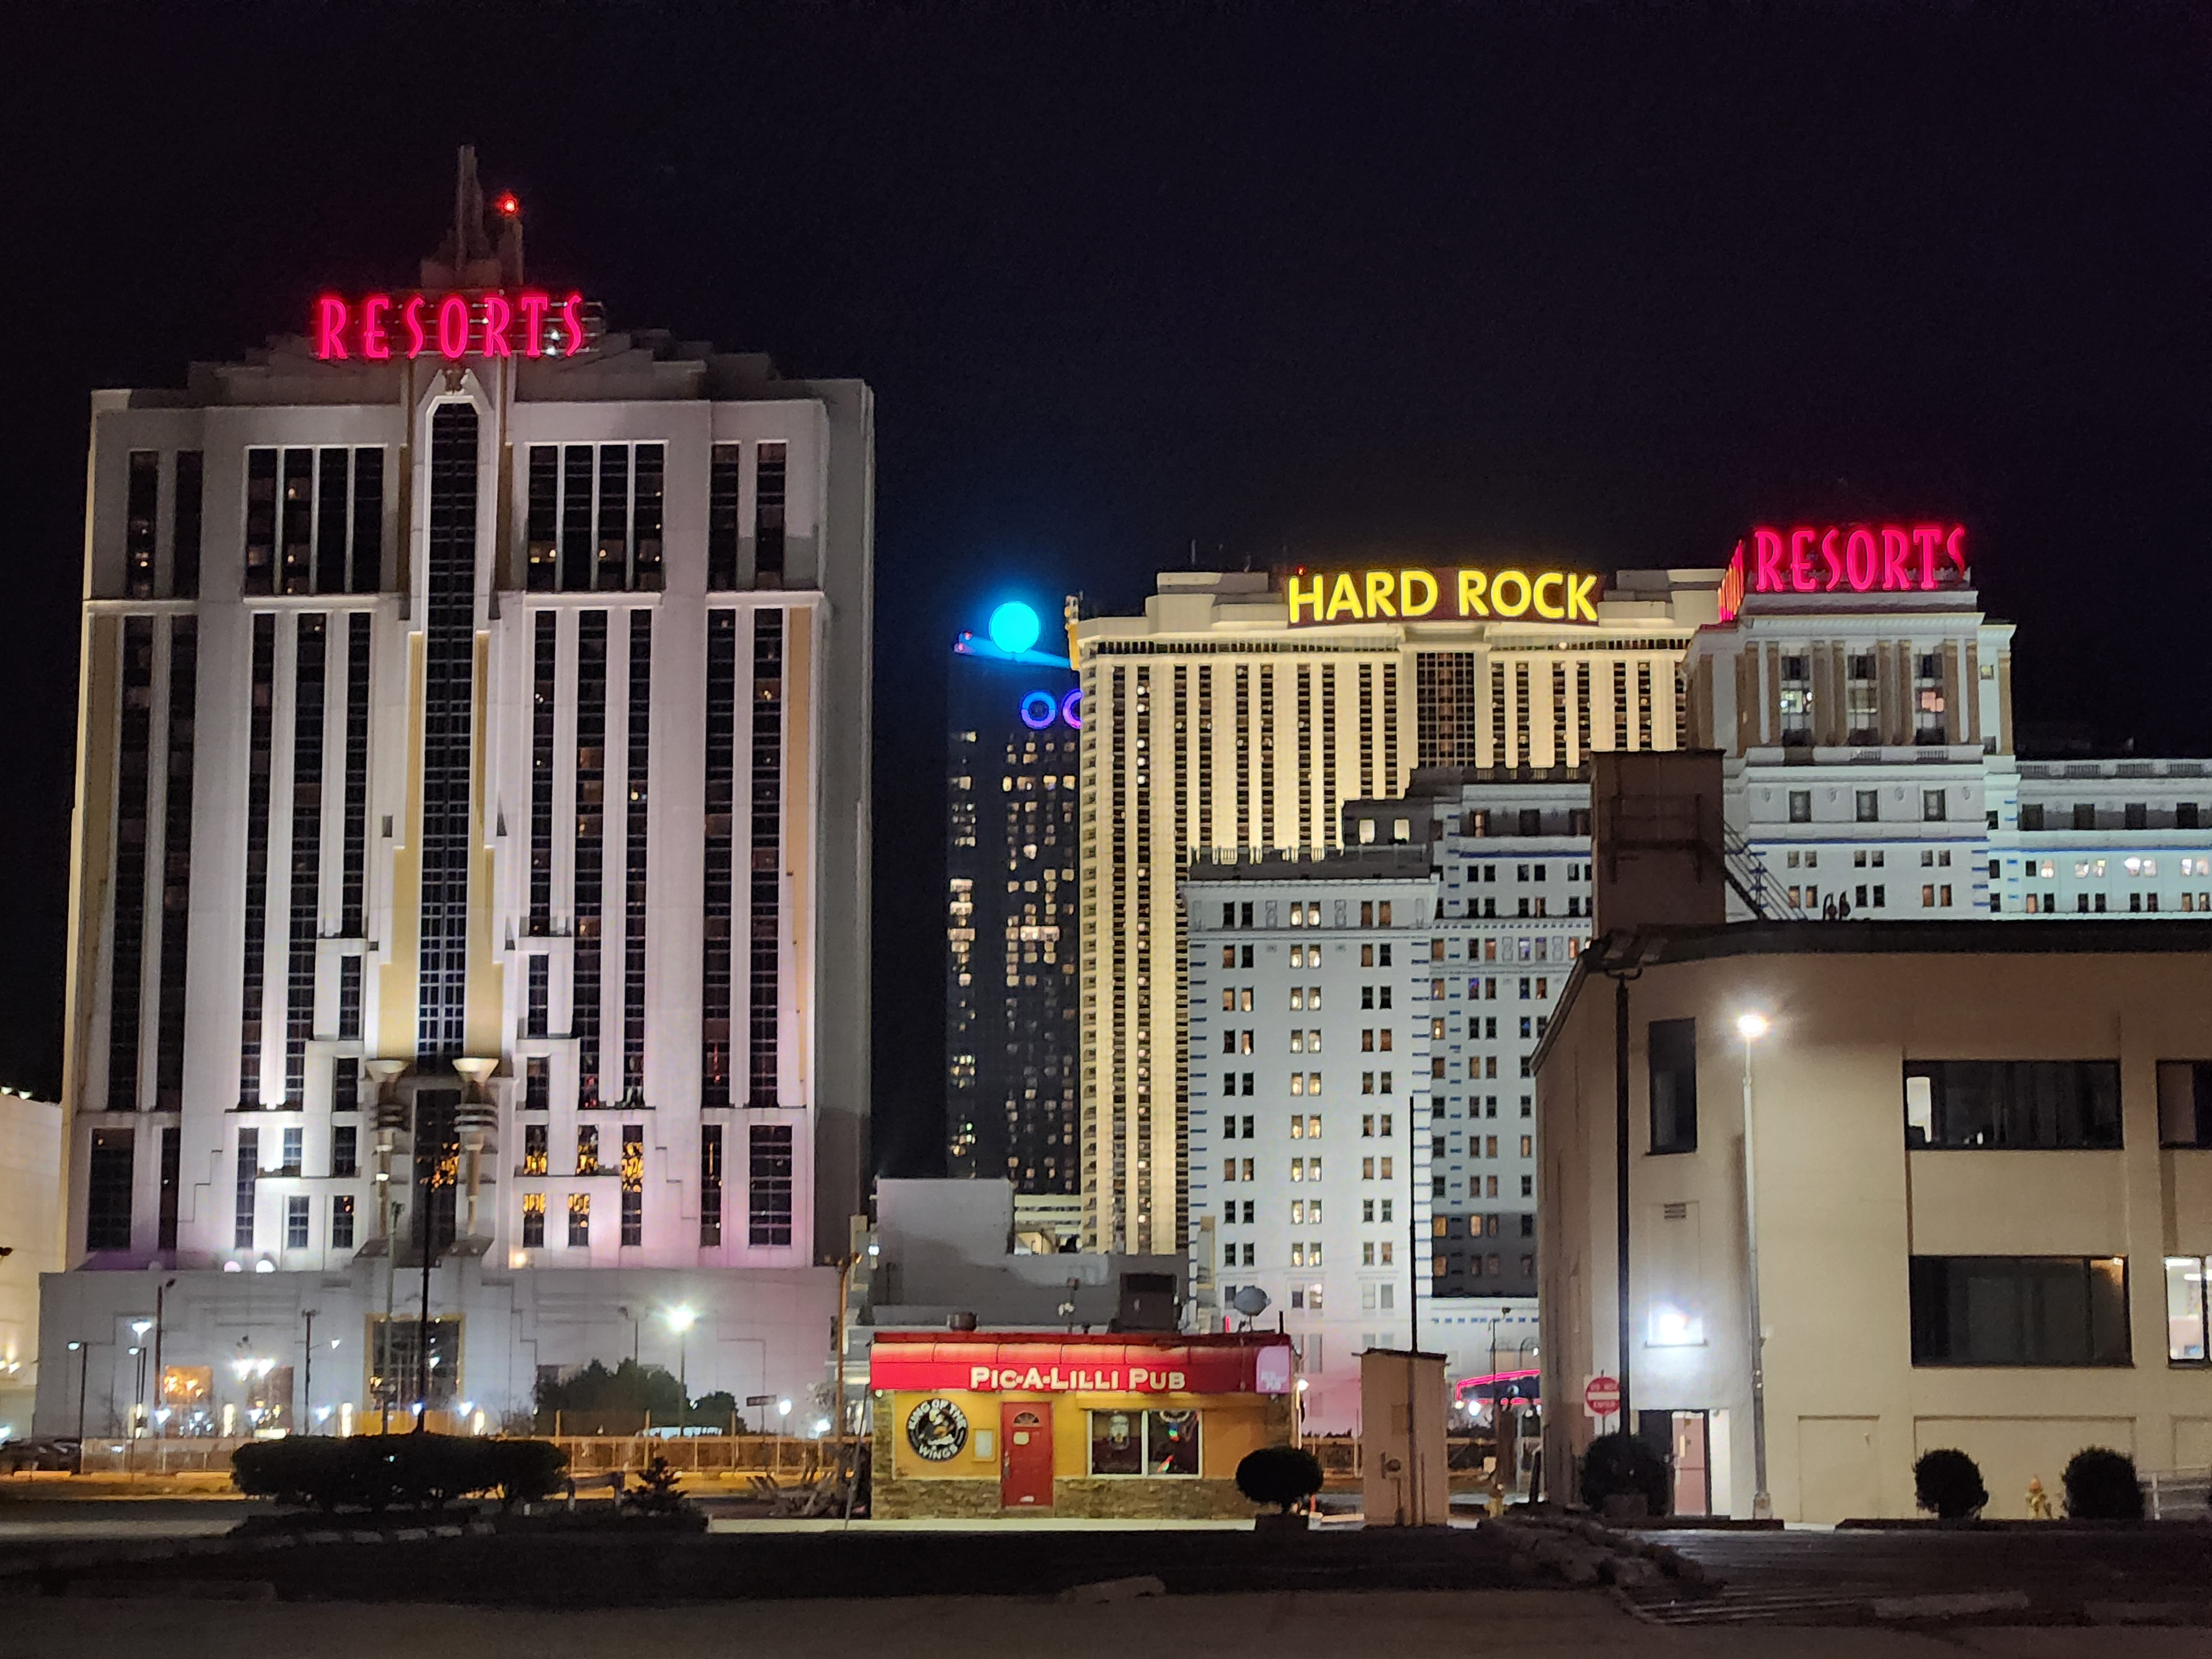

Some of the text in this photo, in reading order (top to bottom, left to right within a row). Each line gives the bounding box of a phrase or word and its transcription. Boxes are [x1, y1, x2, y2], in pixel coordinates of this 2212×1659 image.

[319, 293, 583, 359] RESORTS
[1754, 526, 1965, 592] RESORTS
[1288, 568, 1599, 624] HARD ROCK
[1129, 1367, 1186, 1390] PUB
[919, 1444, 958, 1460] WINGS
